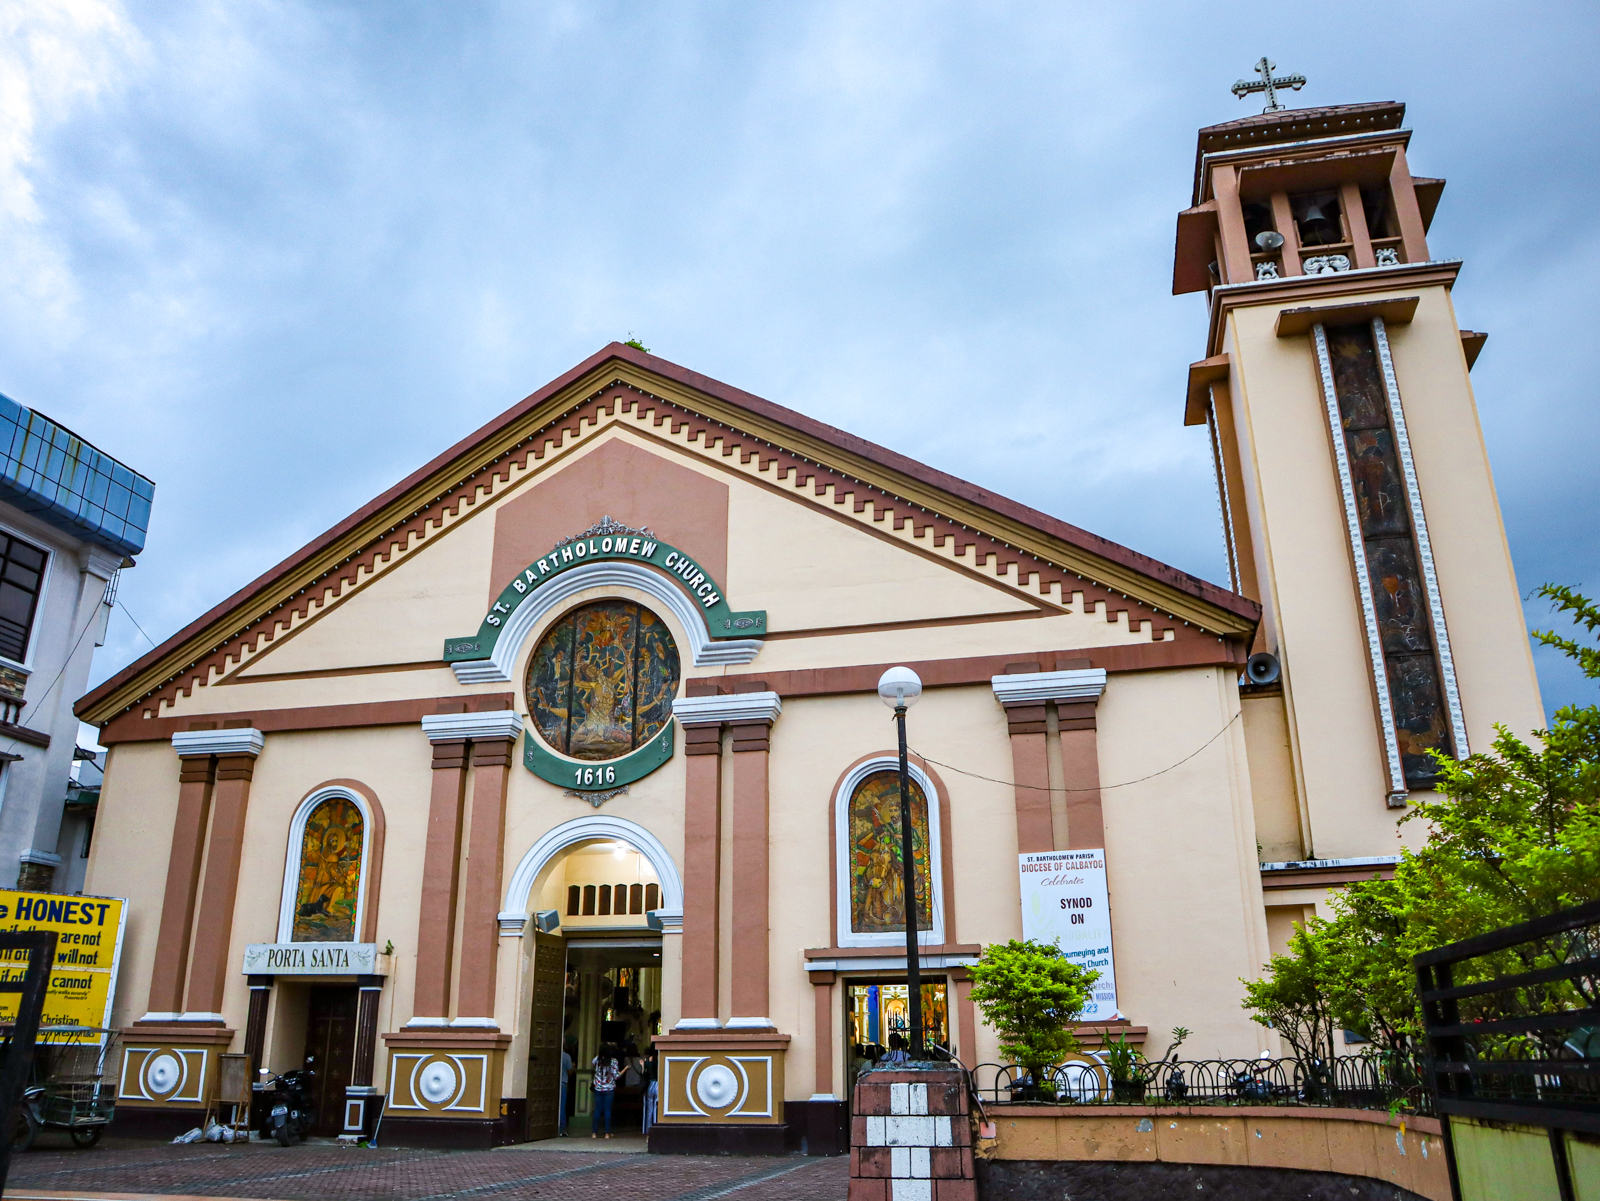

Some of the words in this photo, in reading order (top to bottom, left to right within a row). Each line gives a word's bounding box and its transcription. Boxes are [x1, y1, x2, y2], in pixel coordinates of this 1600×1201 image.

[486, 601, 511, 627] ST.
[512, 537, 657, 594] BARTHOLOMEW
[665, 552, 720, 608] CHURCH
[575, 766, 615, 785] 1616
[1036, 854, 1074, 862] BARTHOLOMEW
[1021, 862, 1052, 873] DIOCESE
[1054, 862, 1063, 871] OF
[1065, 860, 1103, 870] CALBAYOG
[1041, 874, 1084, 886] Celebrates
[1060, 897, 1092, 909] SYNOD
[15, 897, 110, 926] HONEST
[1070, 913, 1084, 925] ON
[60, 932, 80, 944] are
[82, 931, 101, 946] not
[1096, 946, 1109, 955] and
[58, 949, 79, 964] will
[79, 951, 98, 965] not
[266, 949, 305, 968] PORTA
[310, 949, 349, 968] SANTA
[1087, 958, 1109, 968] Church
[52, 974, 93, 989] cannot
[1095, 992, 1114, 1001] MISSION
[41, 1014, 79, 1025] Christian
